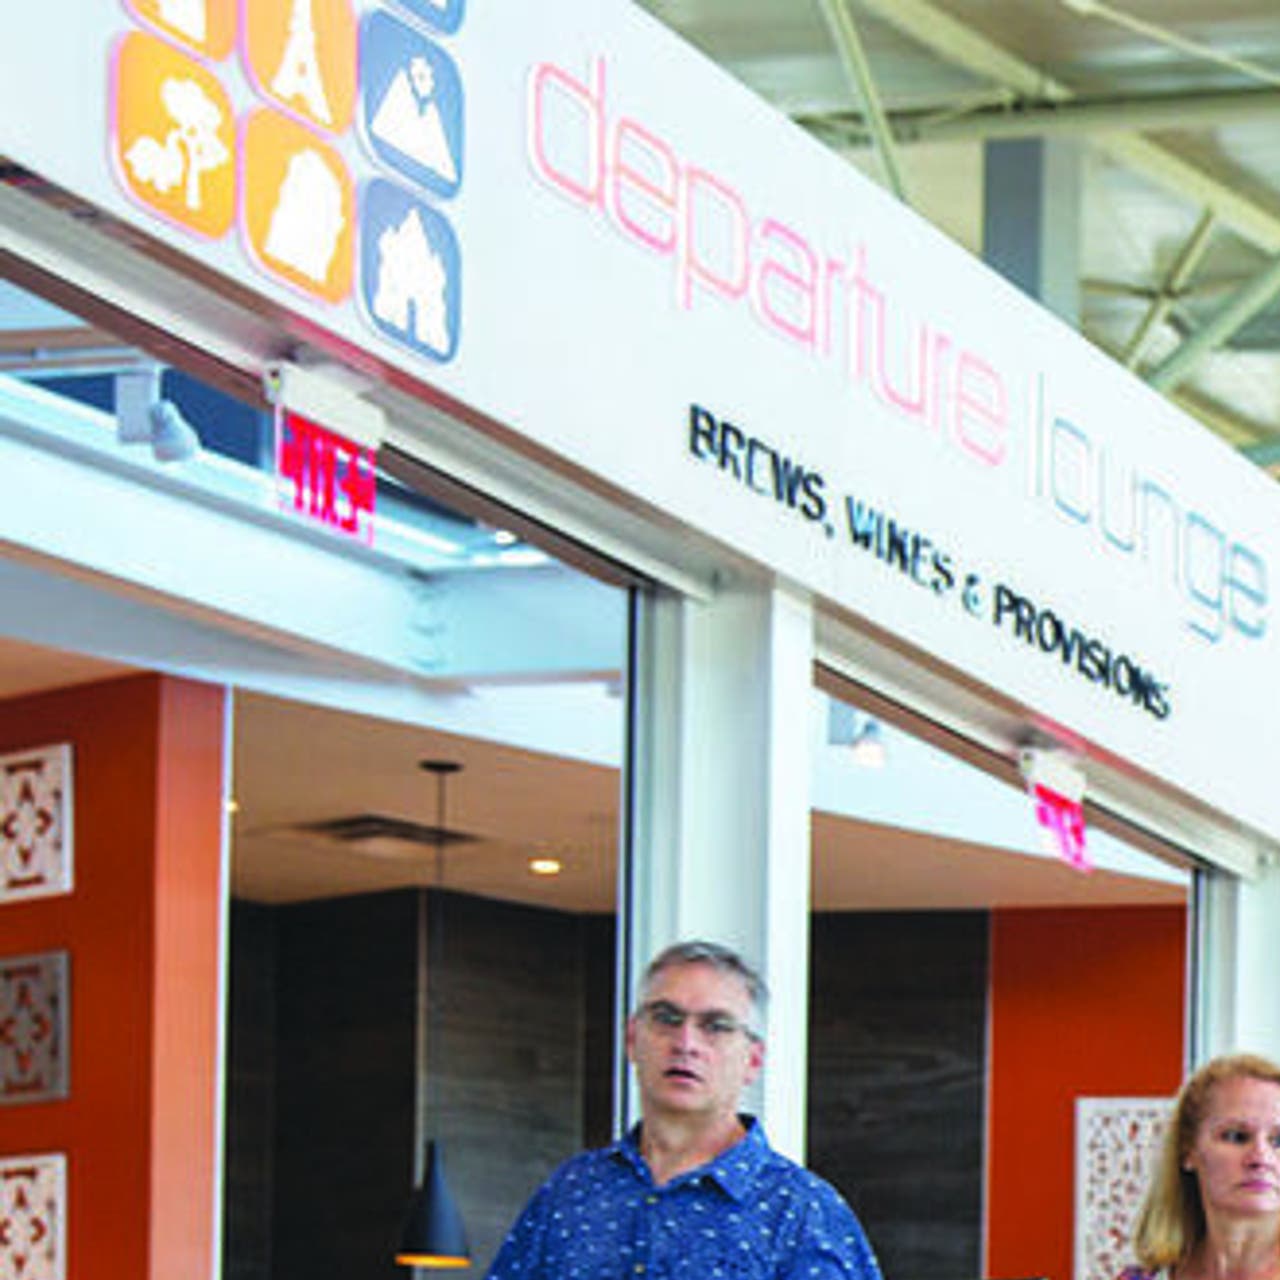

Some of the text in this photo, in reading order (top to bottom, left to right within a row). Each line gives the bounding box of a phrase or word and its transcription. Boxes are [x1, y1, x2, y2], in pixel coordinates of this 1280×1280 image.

[531, 50, 1268, 645] departure lounge
[688, 402, 836, 540] BREWS,
[844, 494, 955, 596] WINES
[992, 582, 1171, 721] PROVISIONS
